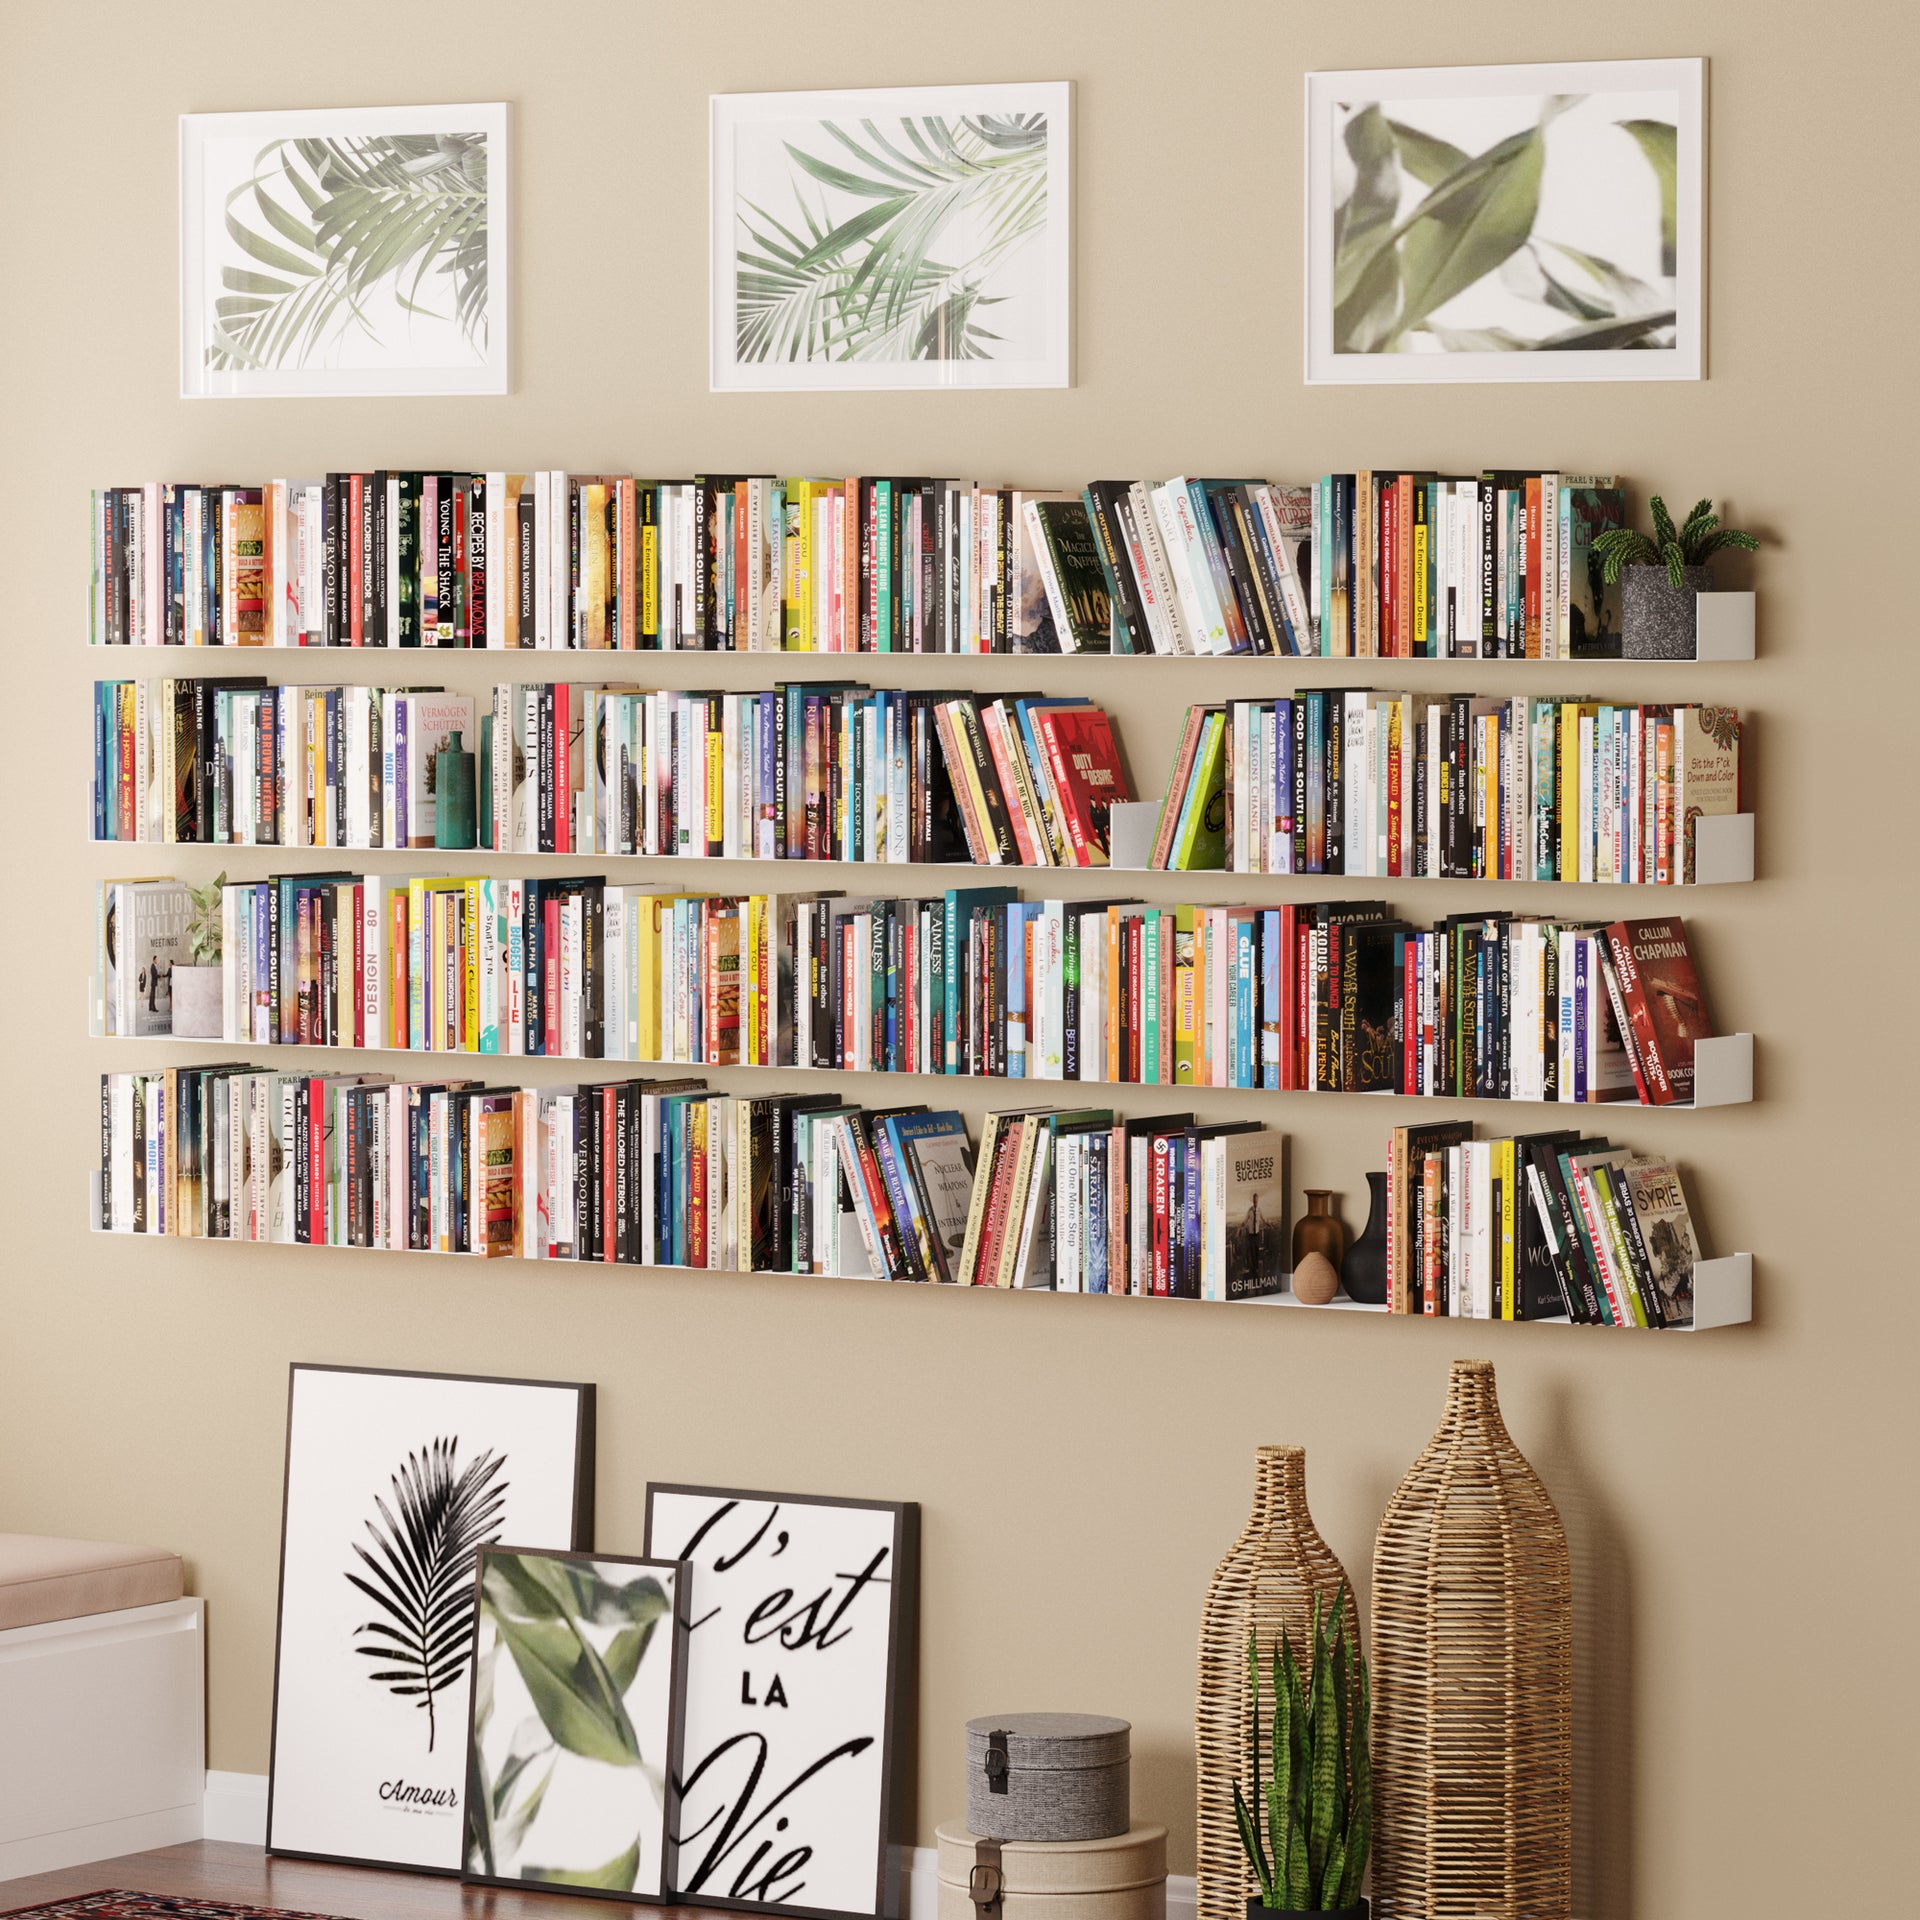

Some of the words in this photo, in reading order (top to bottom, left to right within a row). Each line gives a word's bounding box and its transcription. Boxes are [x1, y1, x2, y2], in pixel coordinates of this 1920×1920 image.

[879, 492, 887, 507] THE
[441, 499, 450, 535] YOUNG
[1093, 493, 1102, 512] THE
[1099, 512, 1117, 564] OUTSIDERS
[472, 512, 484, 553] RECIPES
[440, 546, 450, 569] THE
[472, 557, 484, 569] BY
[879, 532, 887, 566] PRODUCT
[472, 572, 484, 601] REAL
[879, 569, 887, 591] GUIDE
[1135, 543, 1148, 581] ZOMBIE
[1143, 584, 1155, 604] LAW
[440, 571, 450, 608] SHACK
[472, 604, 484, 635] MOMS
[262, 708, 272, 729] DAN
[262, 734, 272, 773] BROWN
[385, 753, 393, 785] MORE
[1010, 760, 1022, 785] SHOOT
[262, 778, 272, 821] INFERNO
[1018, 786, 1026, 798] ME
[1021, 800, 1032, 818] NOW
[367, 910, 377, 927] 80
[1318, 922, 1327, 972] EXODUS
[1330, 926, 1339, 964] DEADLINE
[1638, 927, 1672, 941] CALLUM
[1240, 936, 1249, 978] GLUE
[1611, 937, 1633, 994] CHAPMAN
[1623, 946, 1637, 980] CALLUM
[1634, 942, 1687, 961] CHAPMAN
[367, 954, 377, 1014] DESIGN
[1330, 966, 1339, 976] TO
[1502, 973, 1508, 981] OF
[1330, 978, 1339, 1008] DANGER
[1562, 997, 1571, 1033] MORE
[1318, 1052, 1326, 1081] PENN
[877, 1128, 892, 1158] BEWARE
[1068, 1144, 1077, 1165] Just
[886, 1161, 897, 1176] THE
[1068, 1168, 1077, 1189] One
[1236, 1157, 1274, 1172] BUSINESS
[1237, 1168, 1272, 1182] SUCCESS
[579, 1138, 587, 1229] VERVOORDT
[891, 1177, 904, 1206] REAPER
[1156, 1158, 1164, 1214] KRAKEN
[1636, 1185, 1682, 1211] SYRIE
[1068, 1192, 1077, 1219] More
[1067, 1225, 1077, 1247] Step
[1604, 1200, 1613, 1216] THE
[1618, 1246, 1637, 1295] HANDBOOK
[1244, 1276, 1278, 1290] HILLMAN
[741, 1671, 789, 1708] LA
[379, 1779, 458, 1807] Amour
